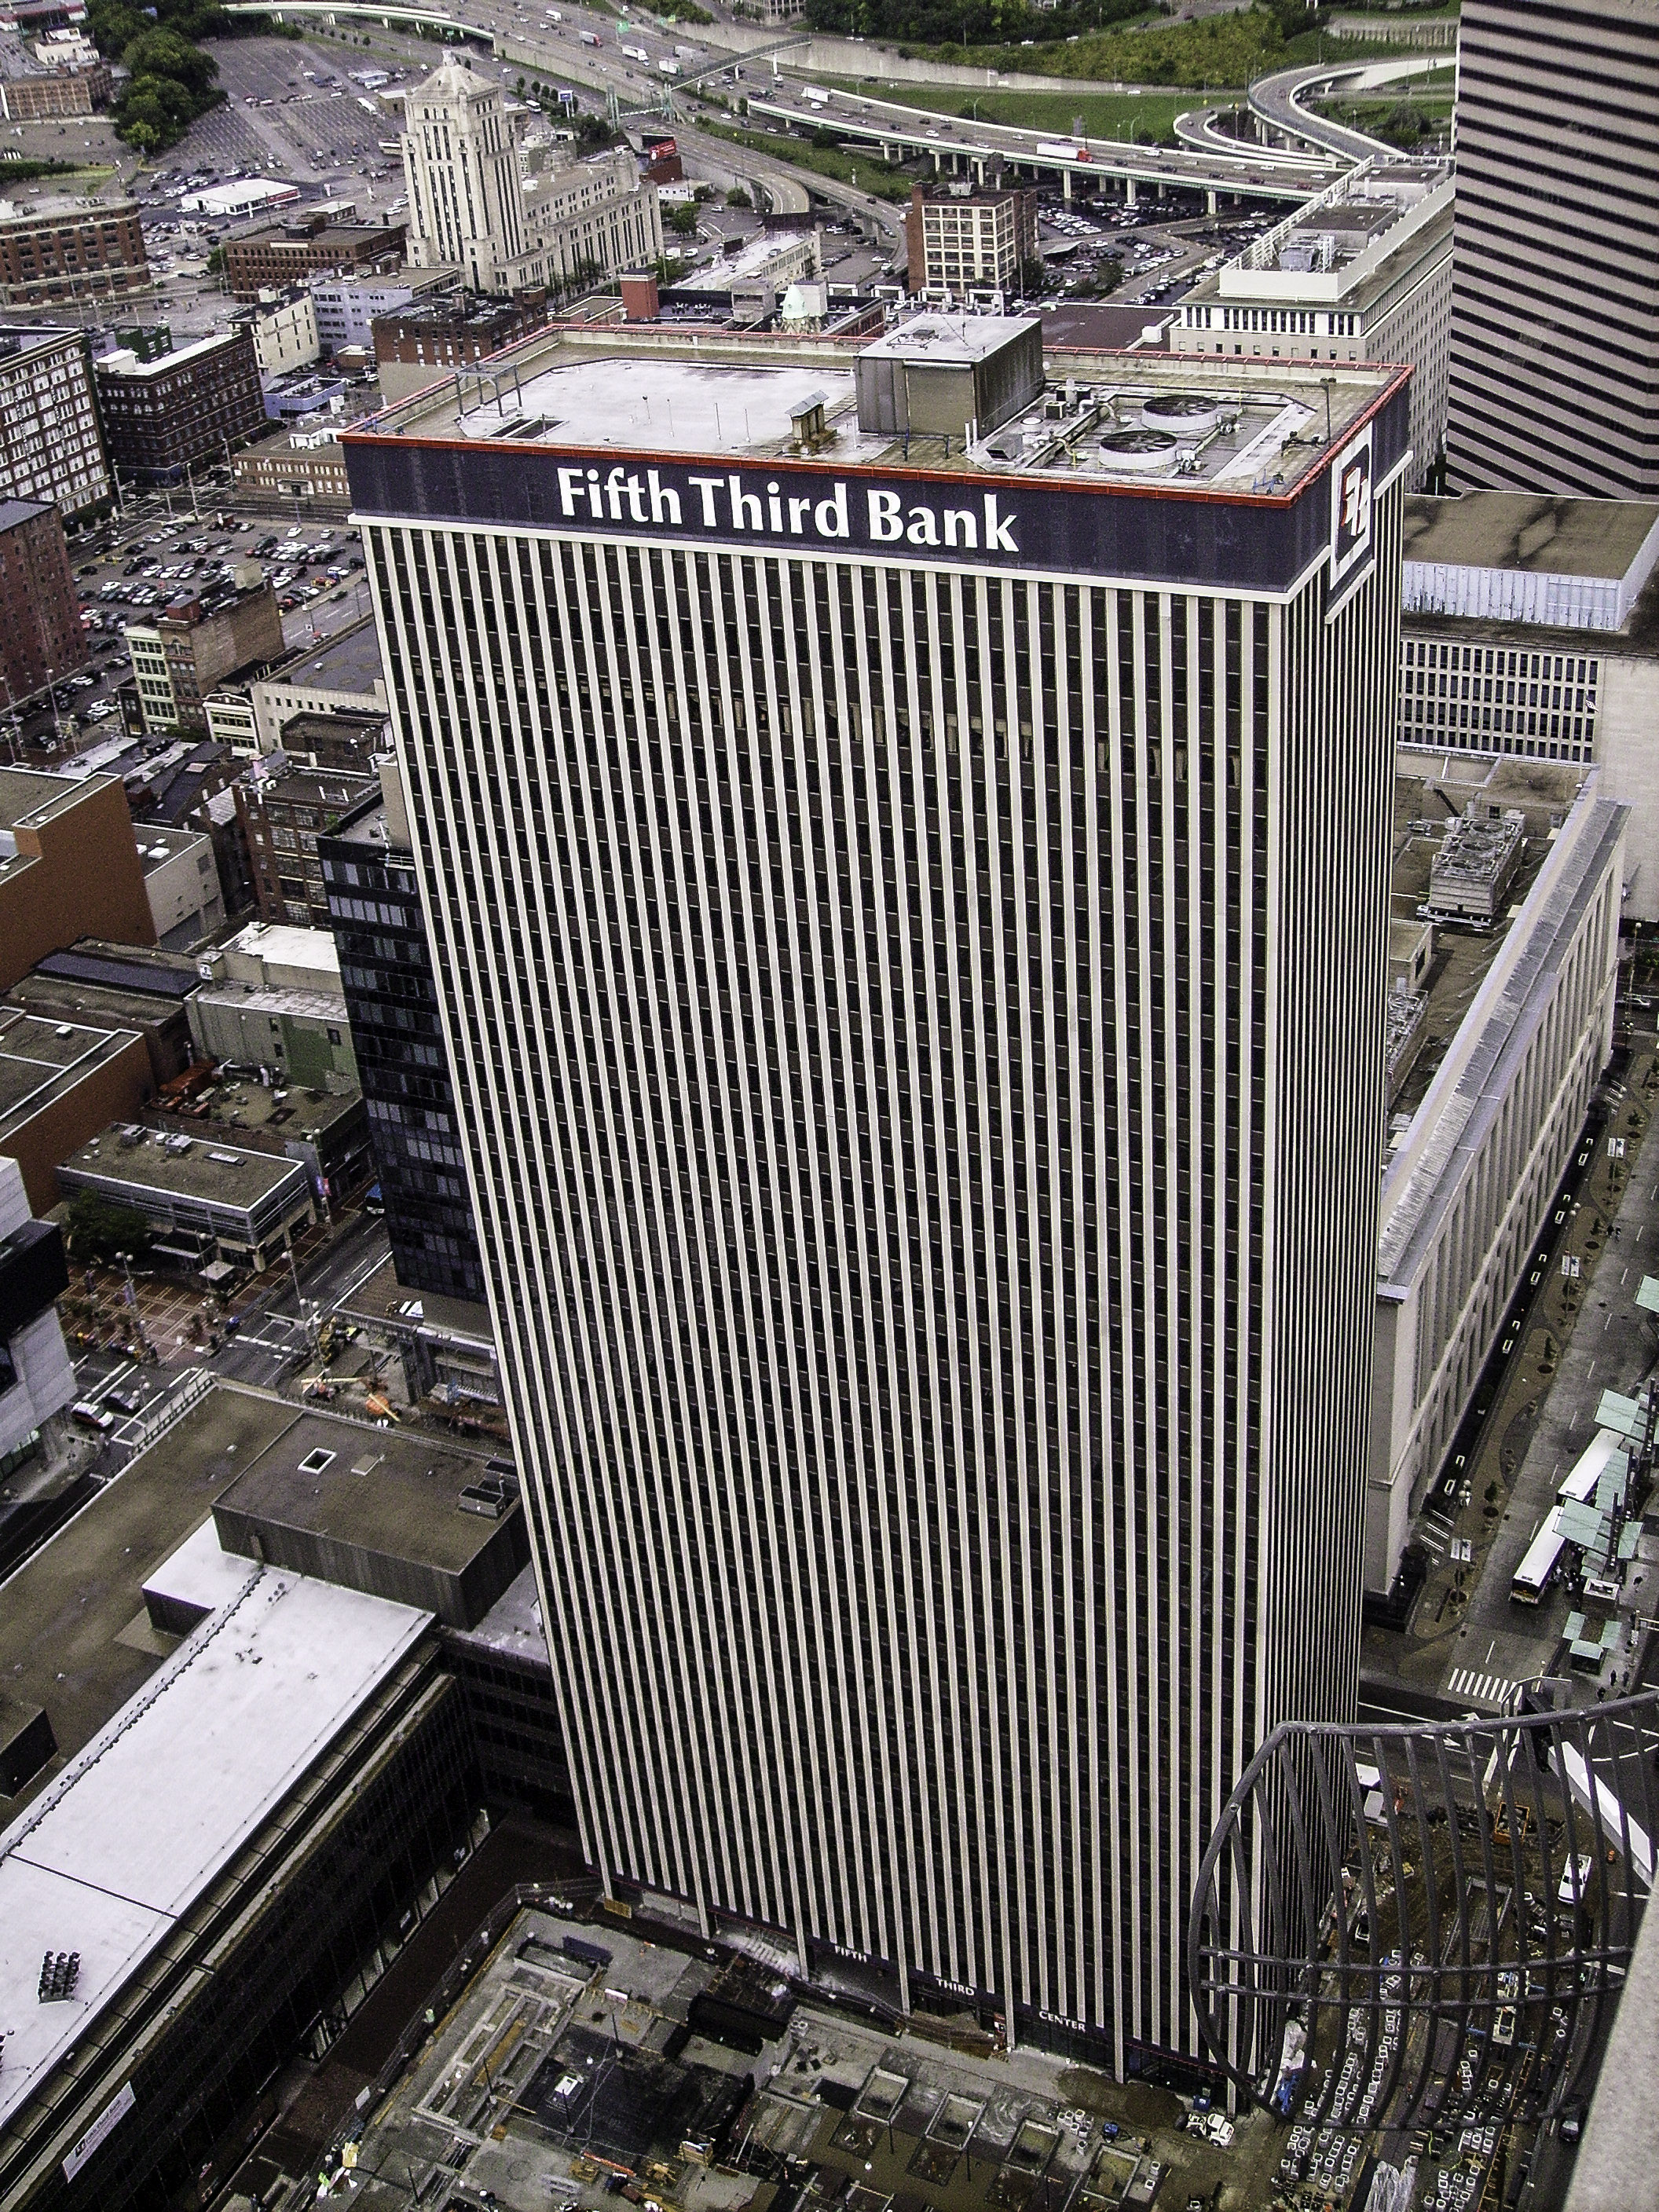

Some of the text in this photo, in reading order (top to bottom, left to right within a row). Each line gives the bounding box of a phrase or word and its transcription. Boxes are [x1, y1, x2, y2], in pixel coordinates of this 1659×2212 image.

[558, 467, 1019, 551] Fifth Third Bank
[834, 1945, 1086, 2032] FIFTH THIRD CENTER
